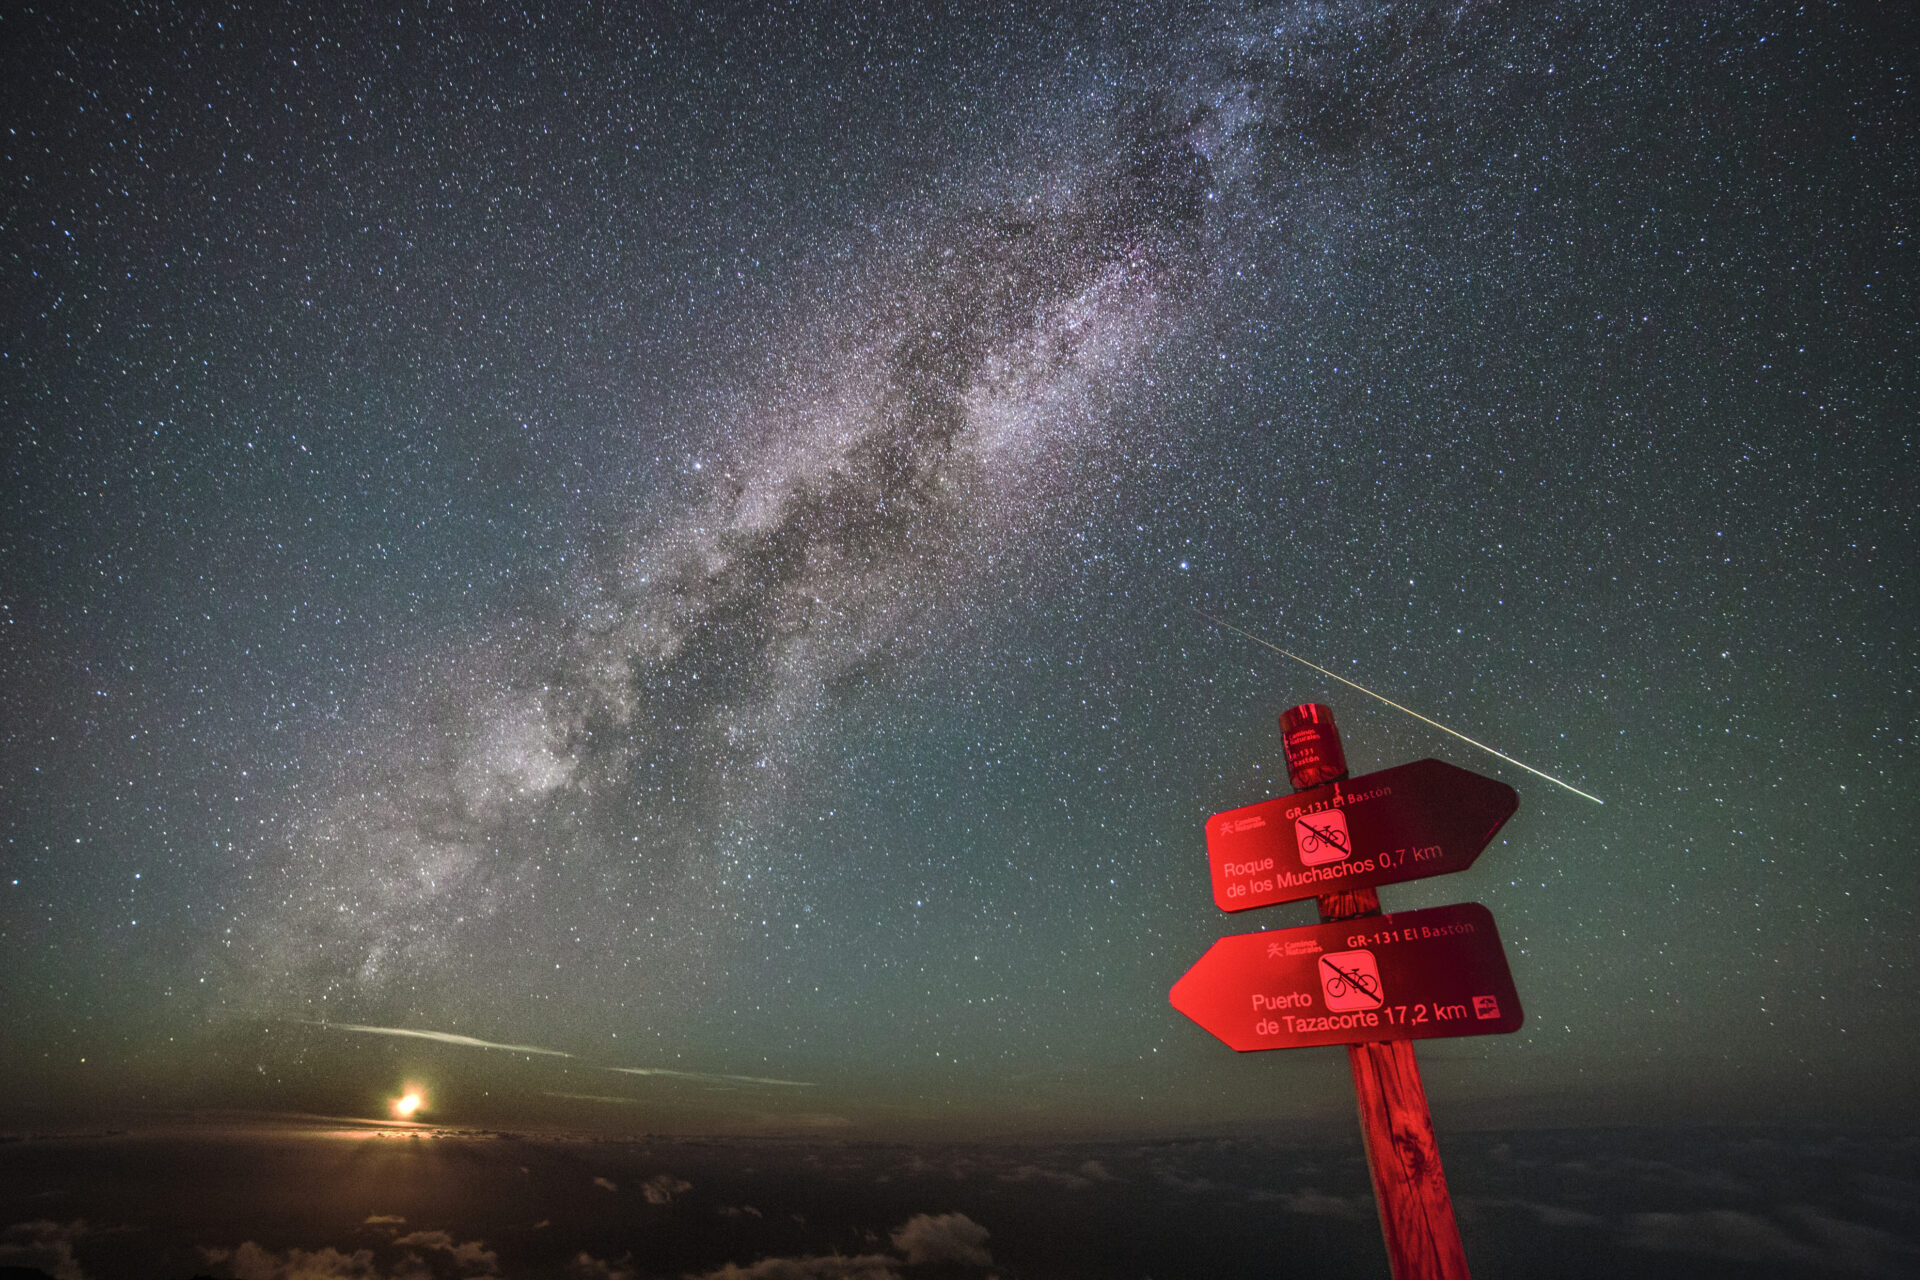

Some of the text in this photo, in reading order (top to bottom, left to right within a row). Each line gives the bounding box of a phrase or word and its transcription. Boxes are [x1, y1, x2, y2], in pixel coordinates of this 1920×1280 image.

[1285, 801, 1329, 820] GR-131
[1348, 785, 1392, 804] Bastón
[1224, 856, 1274, 878] Roque
[1227, 843, 1444, 899] de los Muchachos 0,7 km
[1347, 921, 1475, 949] GR-131 El Bastón
[1252, 992, 1312, 1011] Puerto
[1256, 1002, 1467, 1036] de Tazacorte 17,2 km
